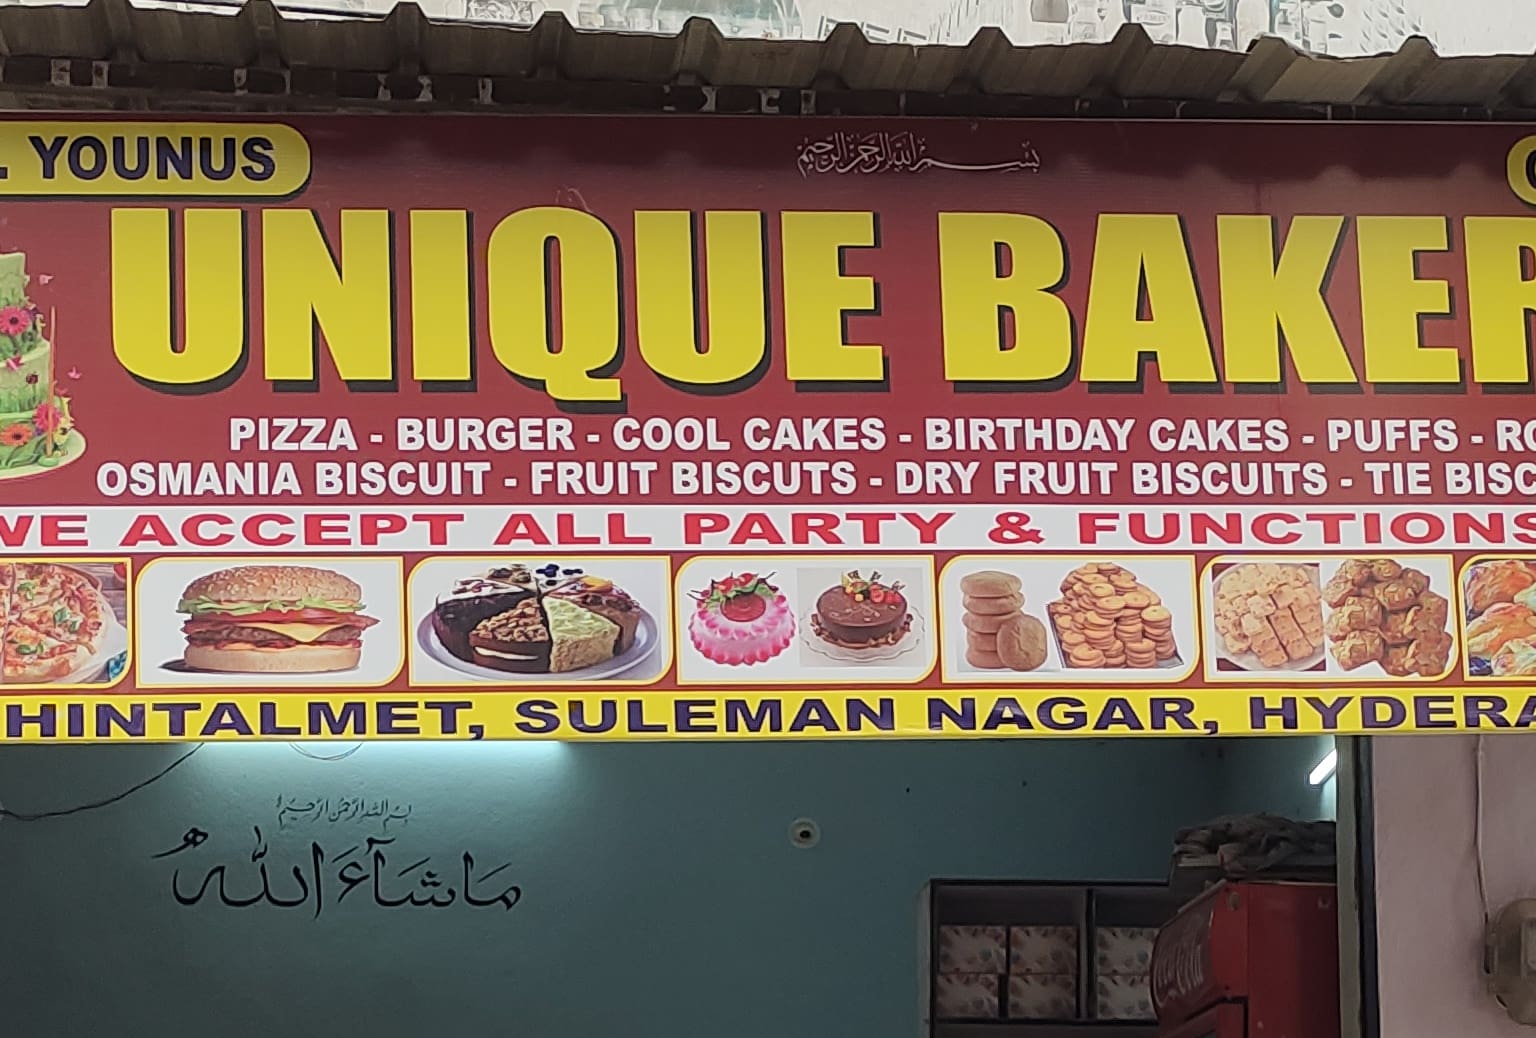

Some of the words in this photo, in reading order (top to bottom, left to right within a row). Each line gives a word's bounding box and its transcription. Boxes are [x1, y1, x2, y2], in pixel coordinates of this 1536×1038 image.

[31, 137, 275, 180] YOUNUS
[110, 206, 885, 401] UNIQUE
[230, 417, 358, 451] PIZZA
[397, 417, 576, 452] BURGER
[613, 417, 731, 451] COOL
[743, 417, 886, 451] CAKES
[925, 417, 1136, 451] BIRTHDAY
[1149, 418, 1290, 452] CAKES
[1327, 418, 1459, 452] PUFFS
[96, 461, 302, 497] OSMANIA
[315, 461, 491, 496] BISCUIT
[531, 461, 658, 495] FRUIT
[671, 461, 857, 495] BISCUTS
[895, 461, 980, 494] DRY
[994, 461, 1118, 495] FRUIT
[1132, 461, 1328, 496] BISCUITS
[1363, 462, 1432, 495] TIE
[120, 513, 465, 547] ACCEPT
[494, 513, 652, 545] ALL
[684, 512, 953, 545] PARTY
[988, 511, 1044, 545] &
[516, 699, 896, 734] SULEMAN
[926, 698, 1219, 735] NAGAR,
